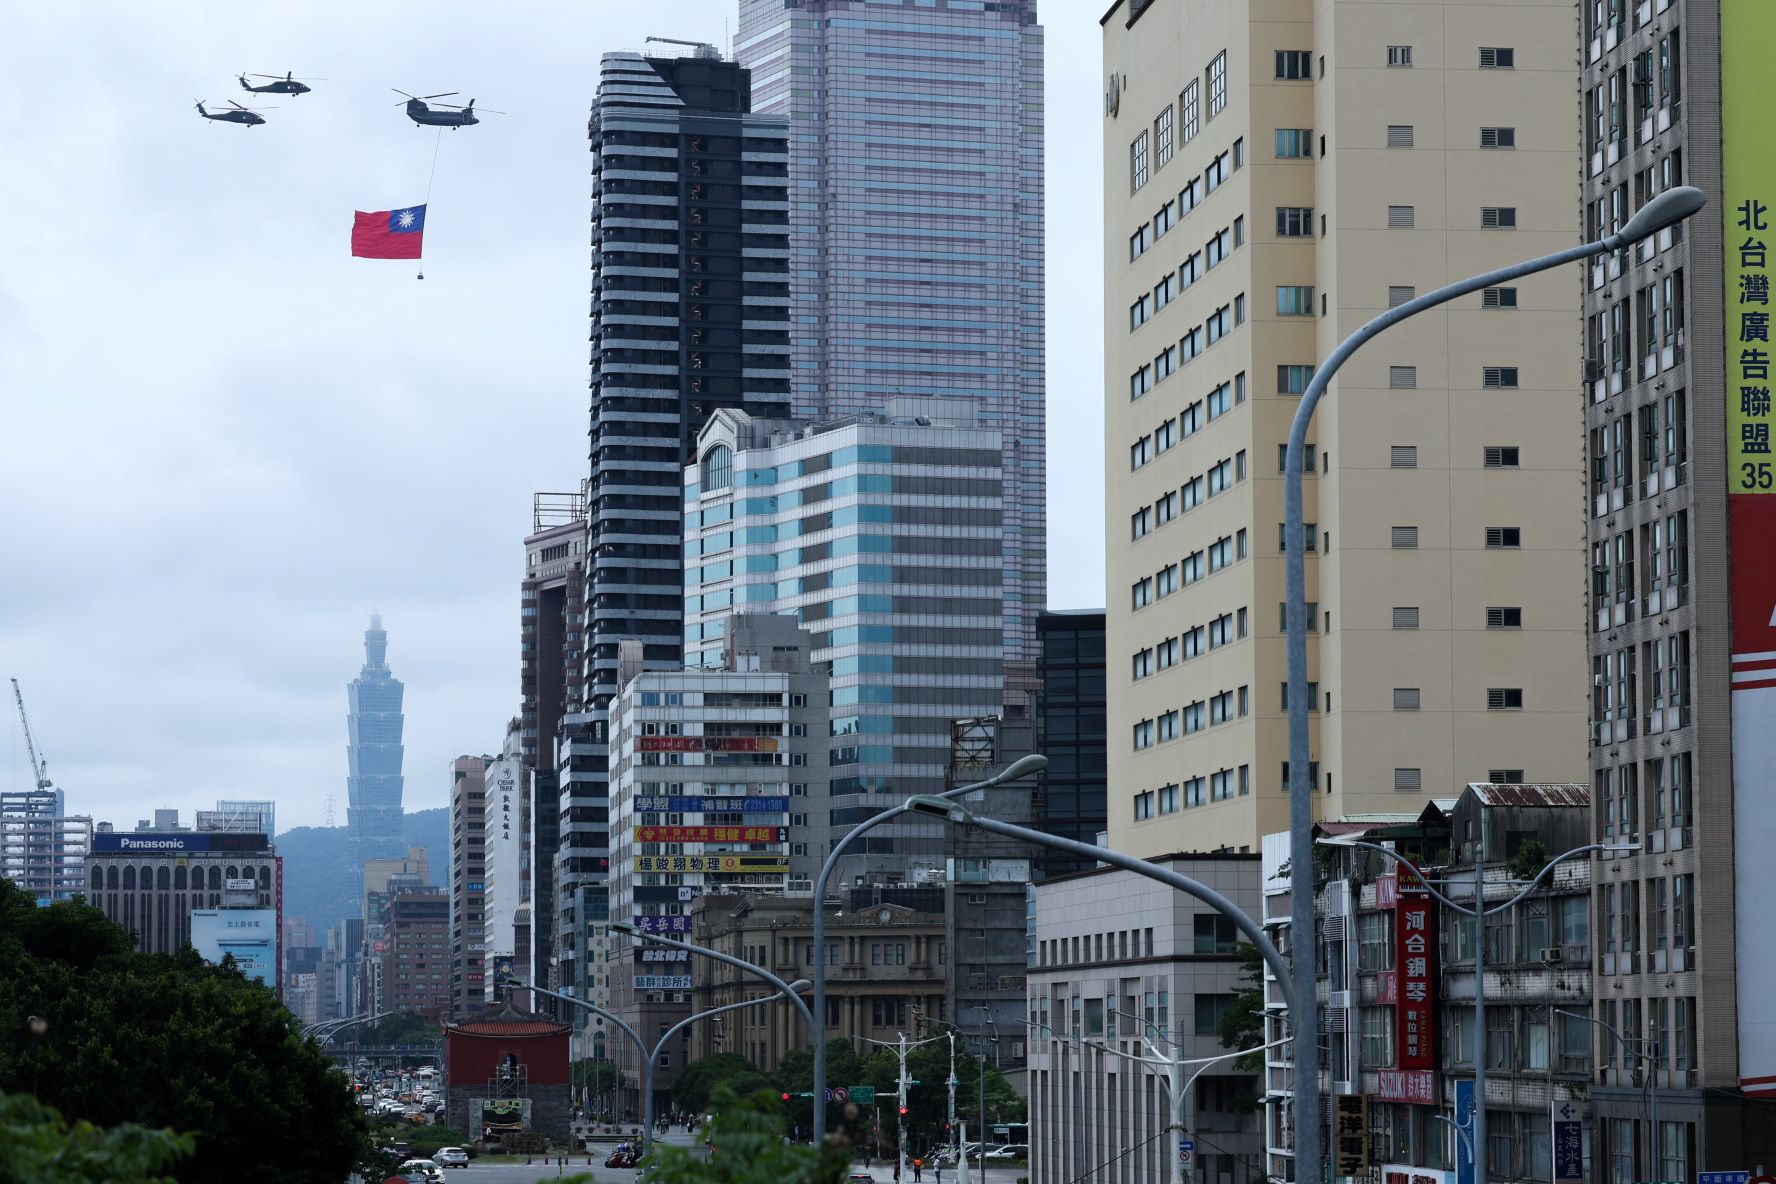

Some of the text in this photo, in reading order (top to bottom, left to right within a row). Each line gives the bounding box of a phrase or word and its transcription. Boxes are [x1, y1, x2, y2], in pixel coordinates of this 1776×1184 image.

[1738, 199, 1772, 454] 北台灣廣告聯盟
[1741, 462, 1774, 489] 35
[120, 838, 185, 848] Panasonic
[639, 917, 692, 931] 吳岳國
[1405, 911, 1428, 1002] 河合鋼琴
[1380, 1071, 1406, 1099] SUZUKI
